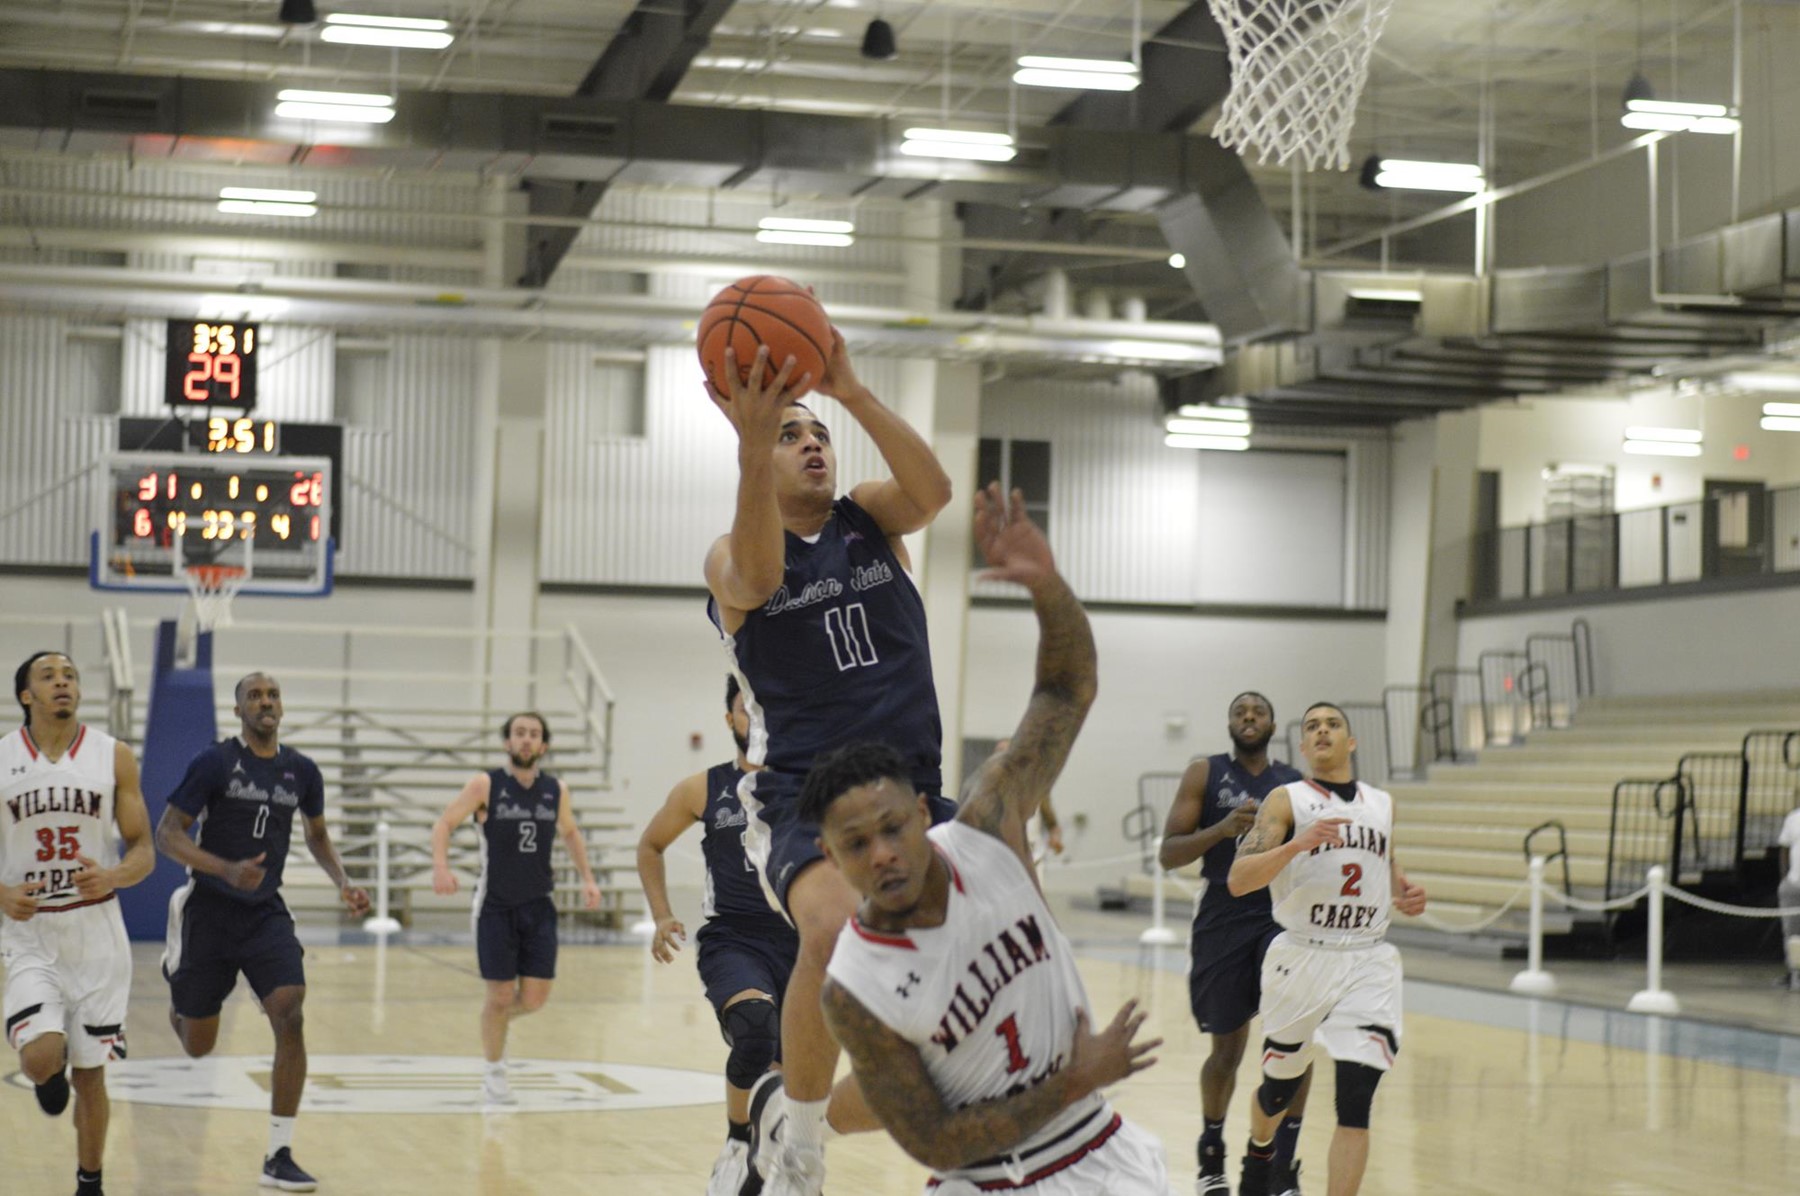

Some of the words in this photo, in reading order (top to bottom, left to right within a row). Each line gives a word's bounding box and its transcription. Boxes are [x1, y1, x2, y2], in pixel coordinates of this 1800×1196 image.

[193, 323, 254, 355] 3:51
[183, 352, 241, 400] 29
[824, 603, 878, 672] 11
[7, 785, 103, 824] WILLIAM
[35, 825, 81, 862] 35
[519, 821, 537, 853] 2
[1309, 824, 1387, 860] LIAM
[24, 866, 84, 897] CARE
[1340, 863, 1363, 897] 2
[1310, 903, 1379, 929] CAREY
[931, 914, 1051, 1055] WILLIAM
[996, 1011, 1030, 1075] 1
